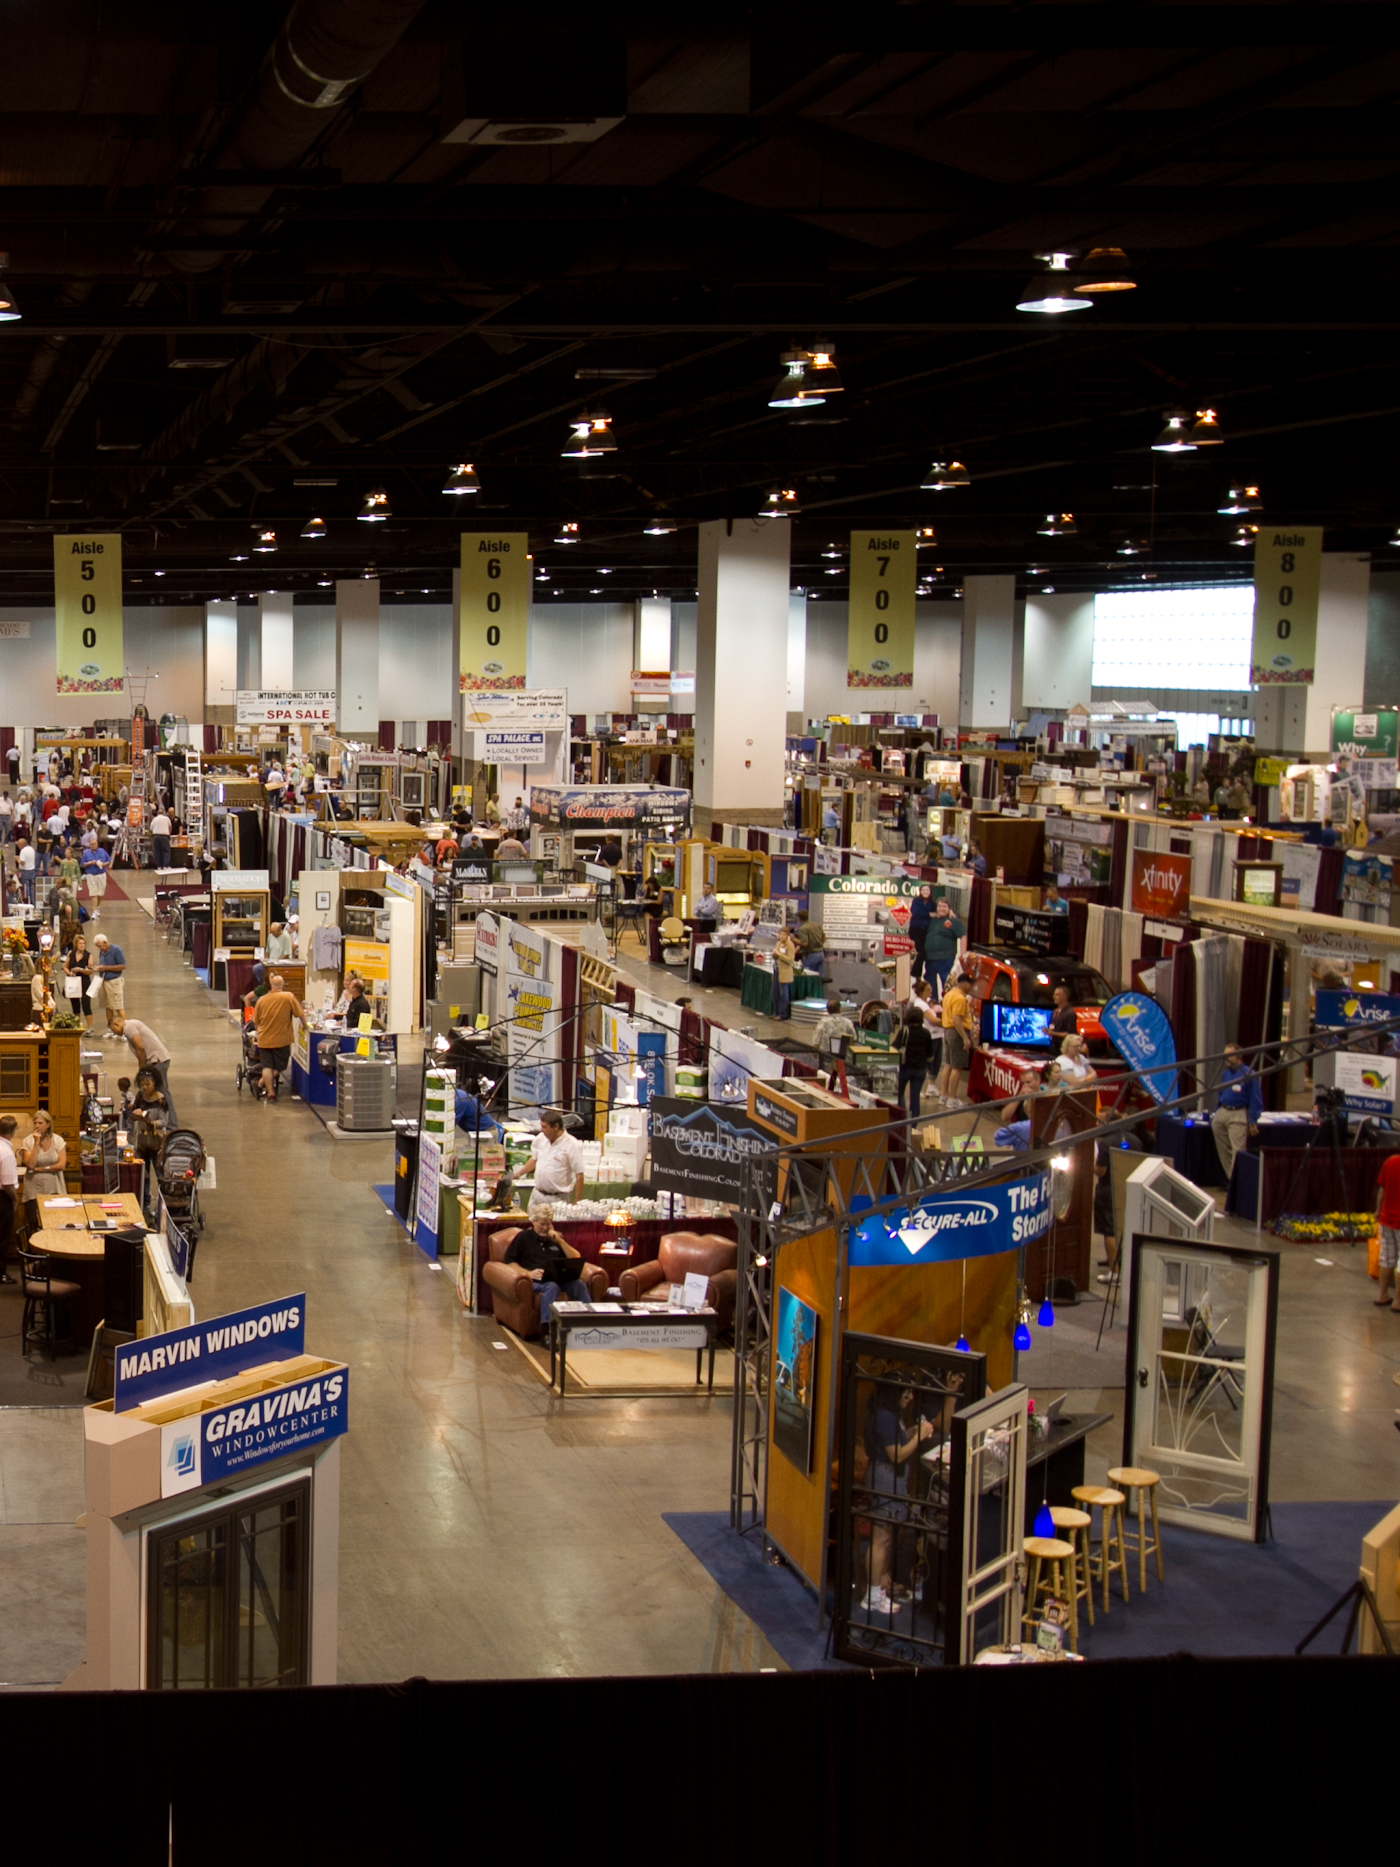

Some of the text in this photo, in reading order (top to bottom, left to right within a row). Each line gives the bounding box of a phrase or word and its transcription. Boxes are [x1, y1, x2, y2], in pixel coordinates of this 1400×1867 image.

[72, 542, 104, 554] Aisle
[478, 540, 510, 552] Aisle
[868, 538, 900, 550] Aisle
[1272, 534, 1305, 546] Aisle
[258, 692, 302, 700] INTERNATIONAL
[267, 710, 330, 719] SPA SALE
[1338, 742, 1366, 756] Why
[566, 803, 635, 822] Champion
[829, 878, 898, 894] Colorado
[1141, 864, 1182, 897] xfinity
[476, 921, 497, 948] Rinnai
[1319, 935, 1368, 951] SOLARA
[513, 1003, 544, 1022] PLUMBING
[1351, 1000, 1391, 1021] Arise
[1126, 1014, 1156, 1055] Arise
[984, 1058, 1021, 1096] xfinity
[1345, 1096, 1386, 1110] Why Solar?
[652, 1112, 715, 1143] BASEMENT
[1008, 1185, 1037, 1213] The
[901, 1209, 987, 1231] SECURE-ALL
[1011, 1207, 1049, 1242] Storm
[120, 1307, 300, 1381] MARVIN WINDOWS
[205, 1375, 343, 1442] GRAVINA'S
[212, 1405, 338, 1458] WINDOWCENTER
[227, 1426, 325, 1467] www.Windowsforyourhome.com
